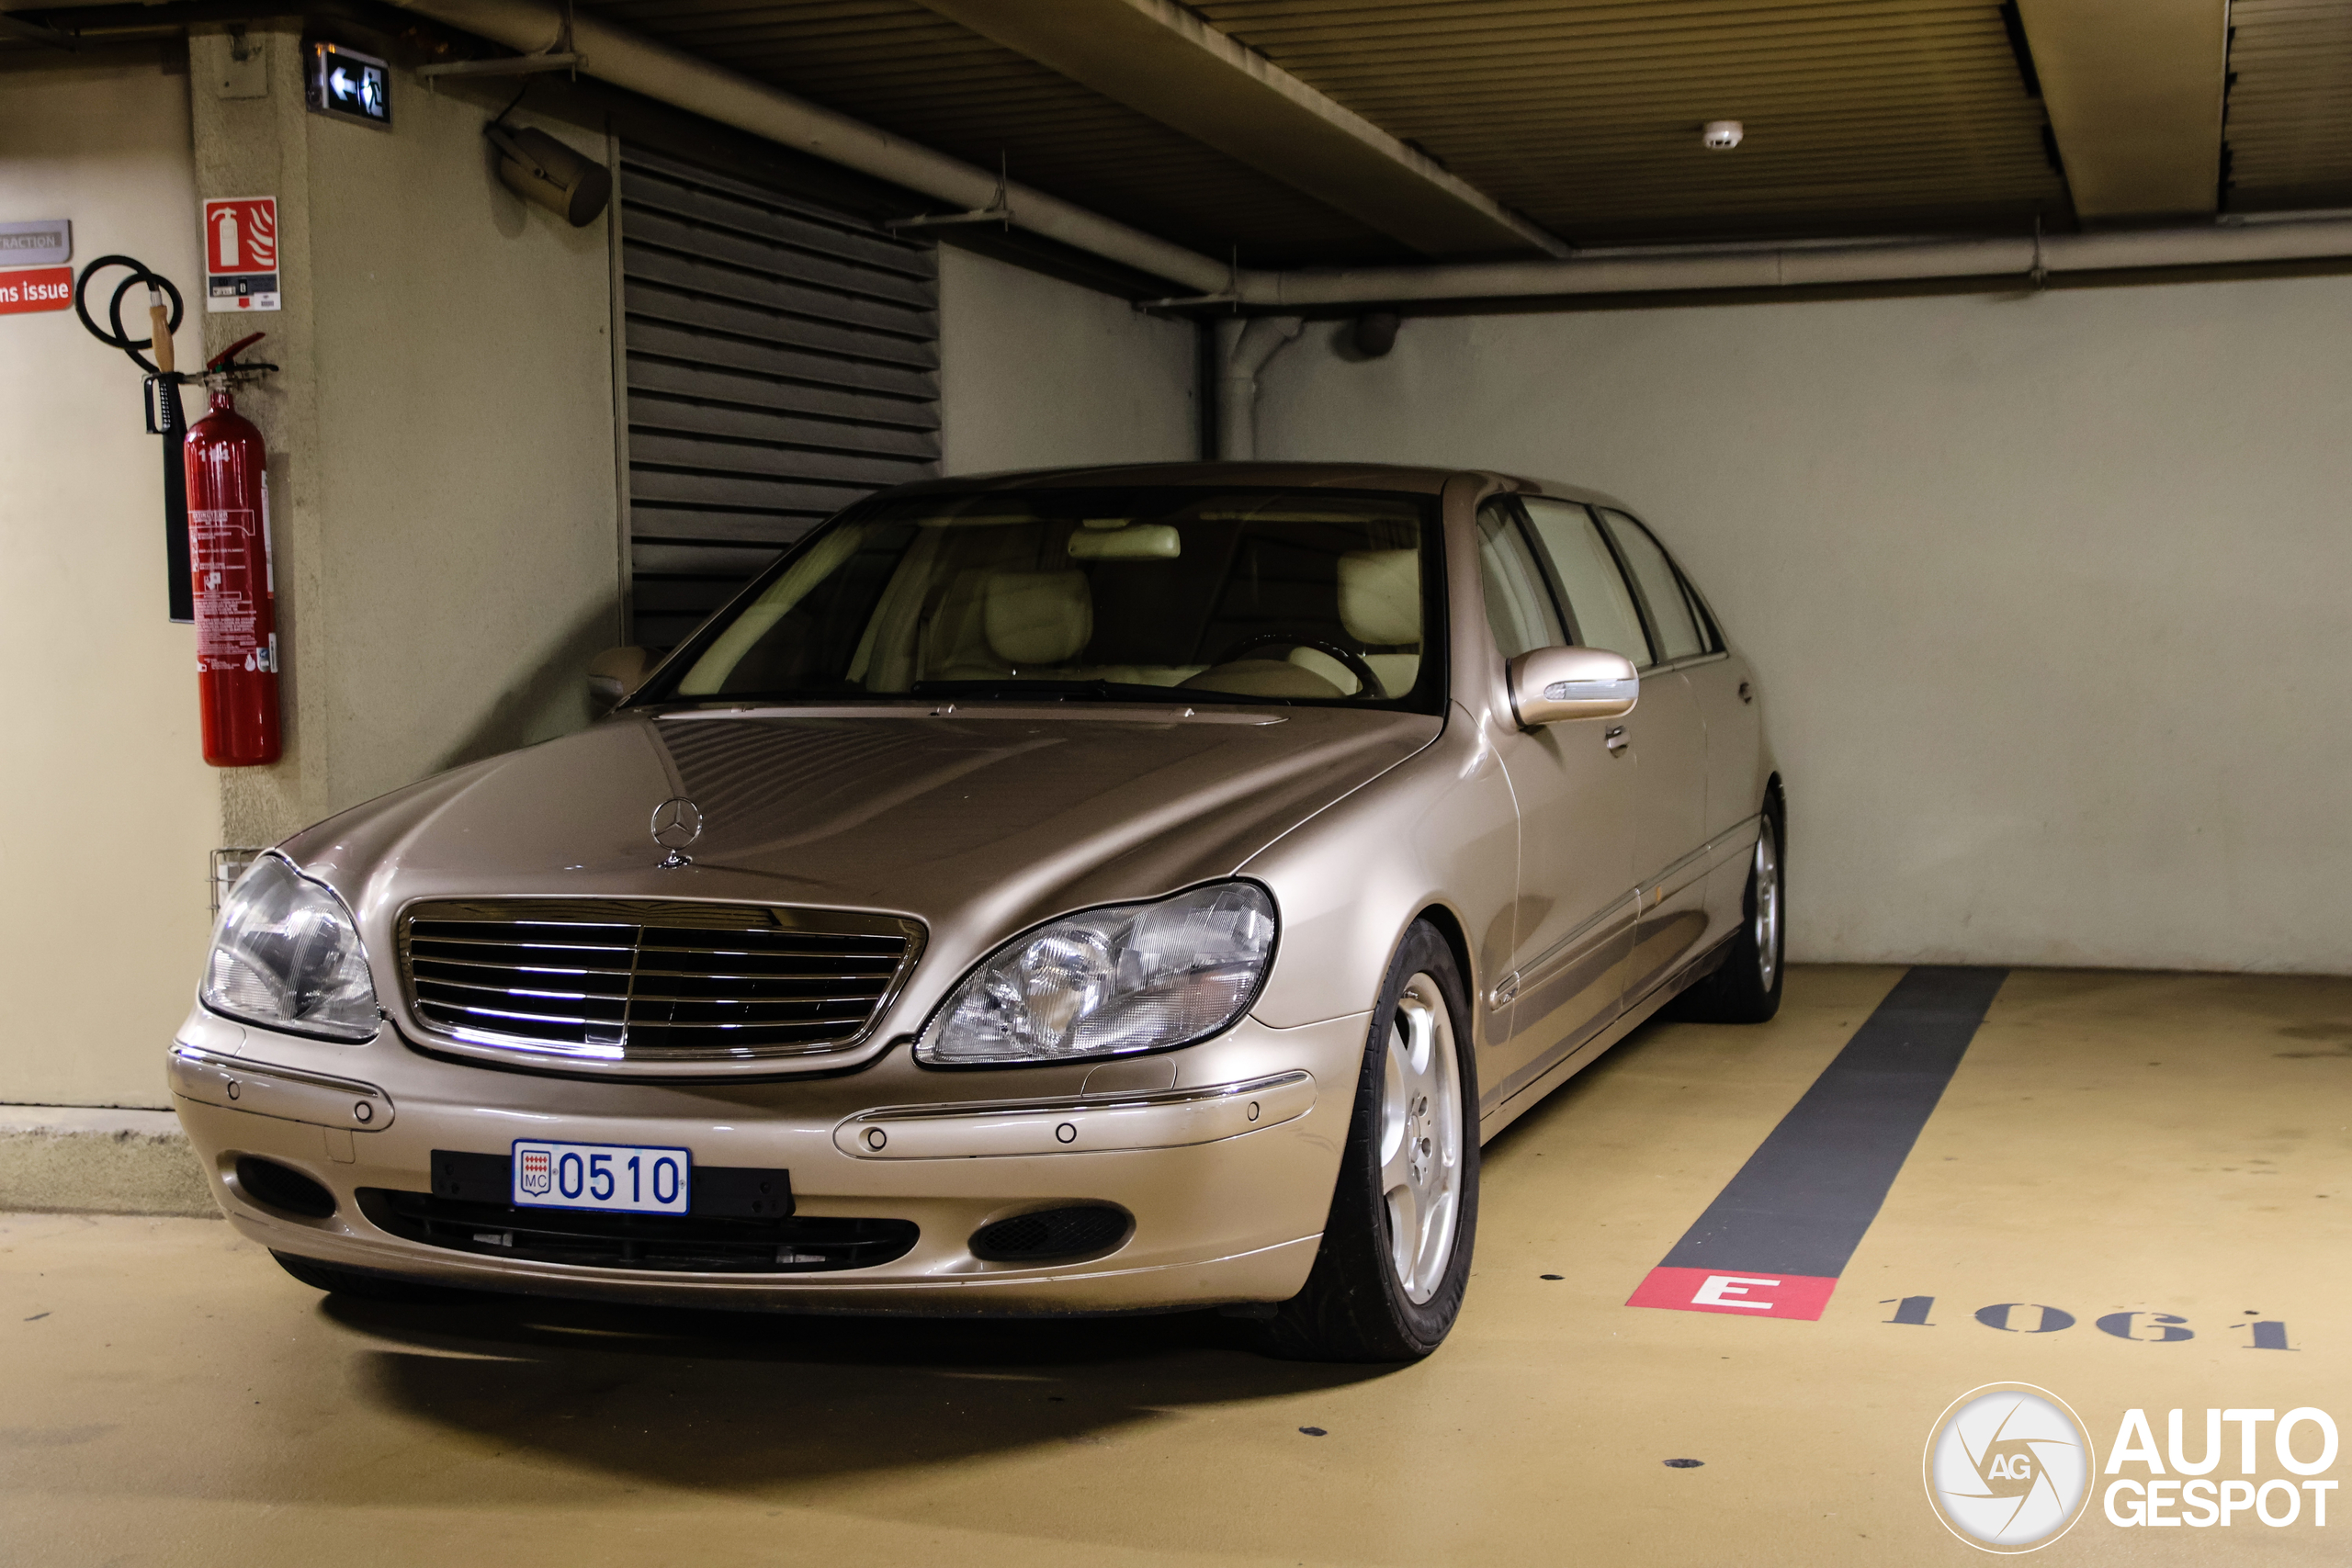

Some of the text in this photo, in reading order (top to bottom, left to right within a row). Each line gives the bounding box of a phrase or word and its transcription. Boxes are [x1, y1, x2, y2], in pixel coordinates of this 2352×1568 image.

[0, 236, 55, 248] RACTION
[23, 280, 69, 301] issue
[525, 1152, 679, 1204] MC 0510
[1690, 1275, 1781, 1309] E
[1879, 1295, 2301, 1351] 1061
